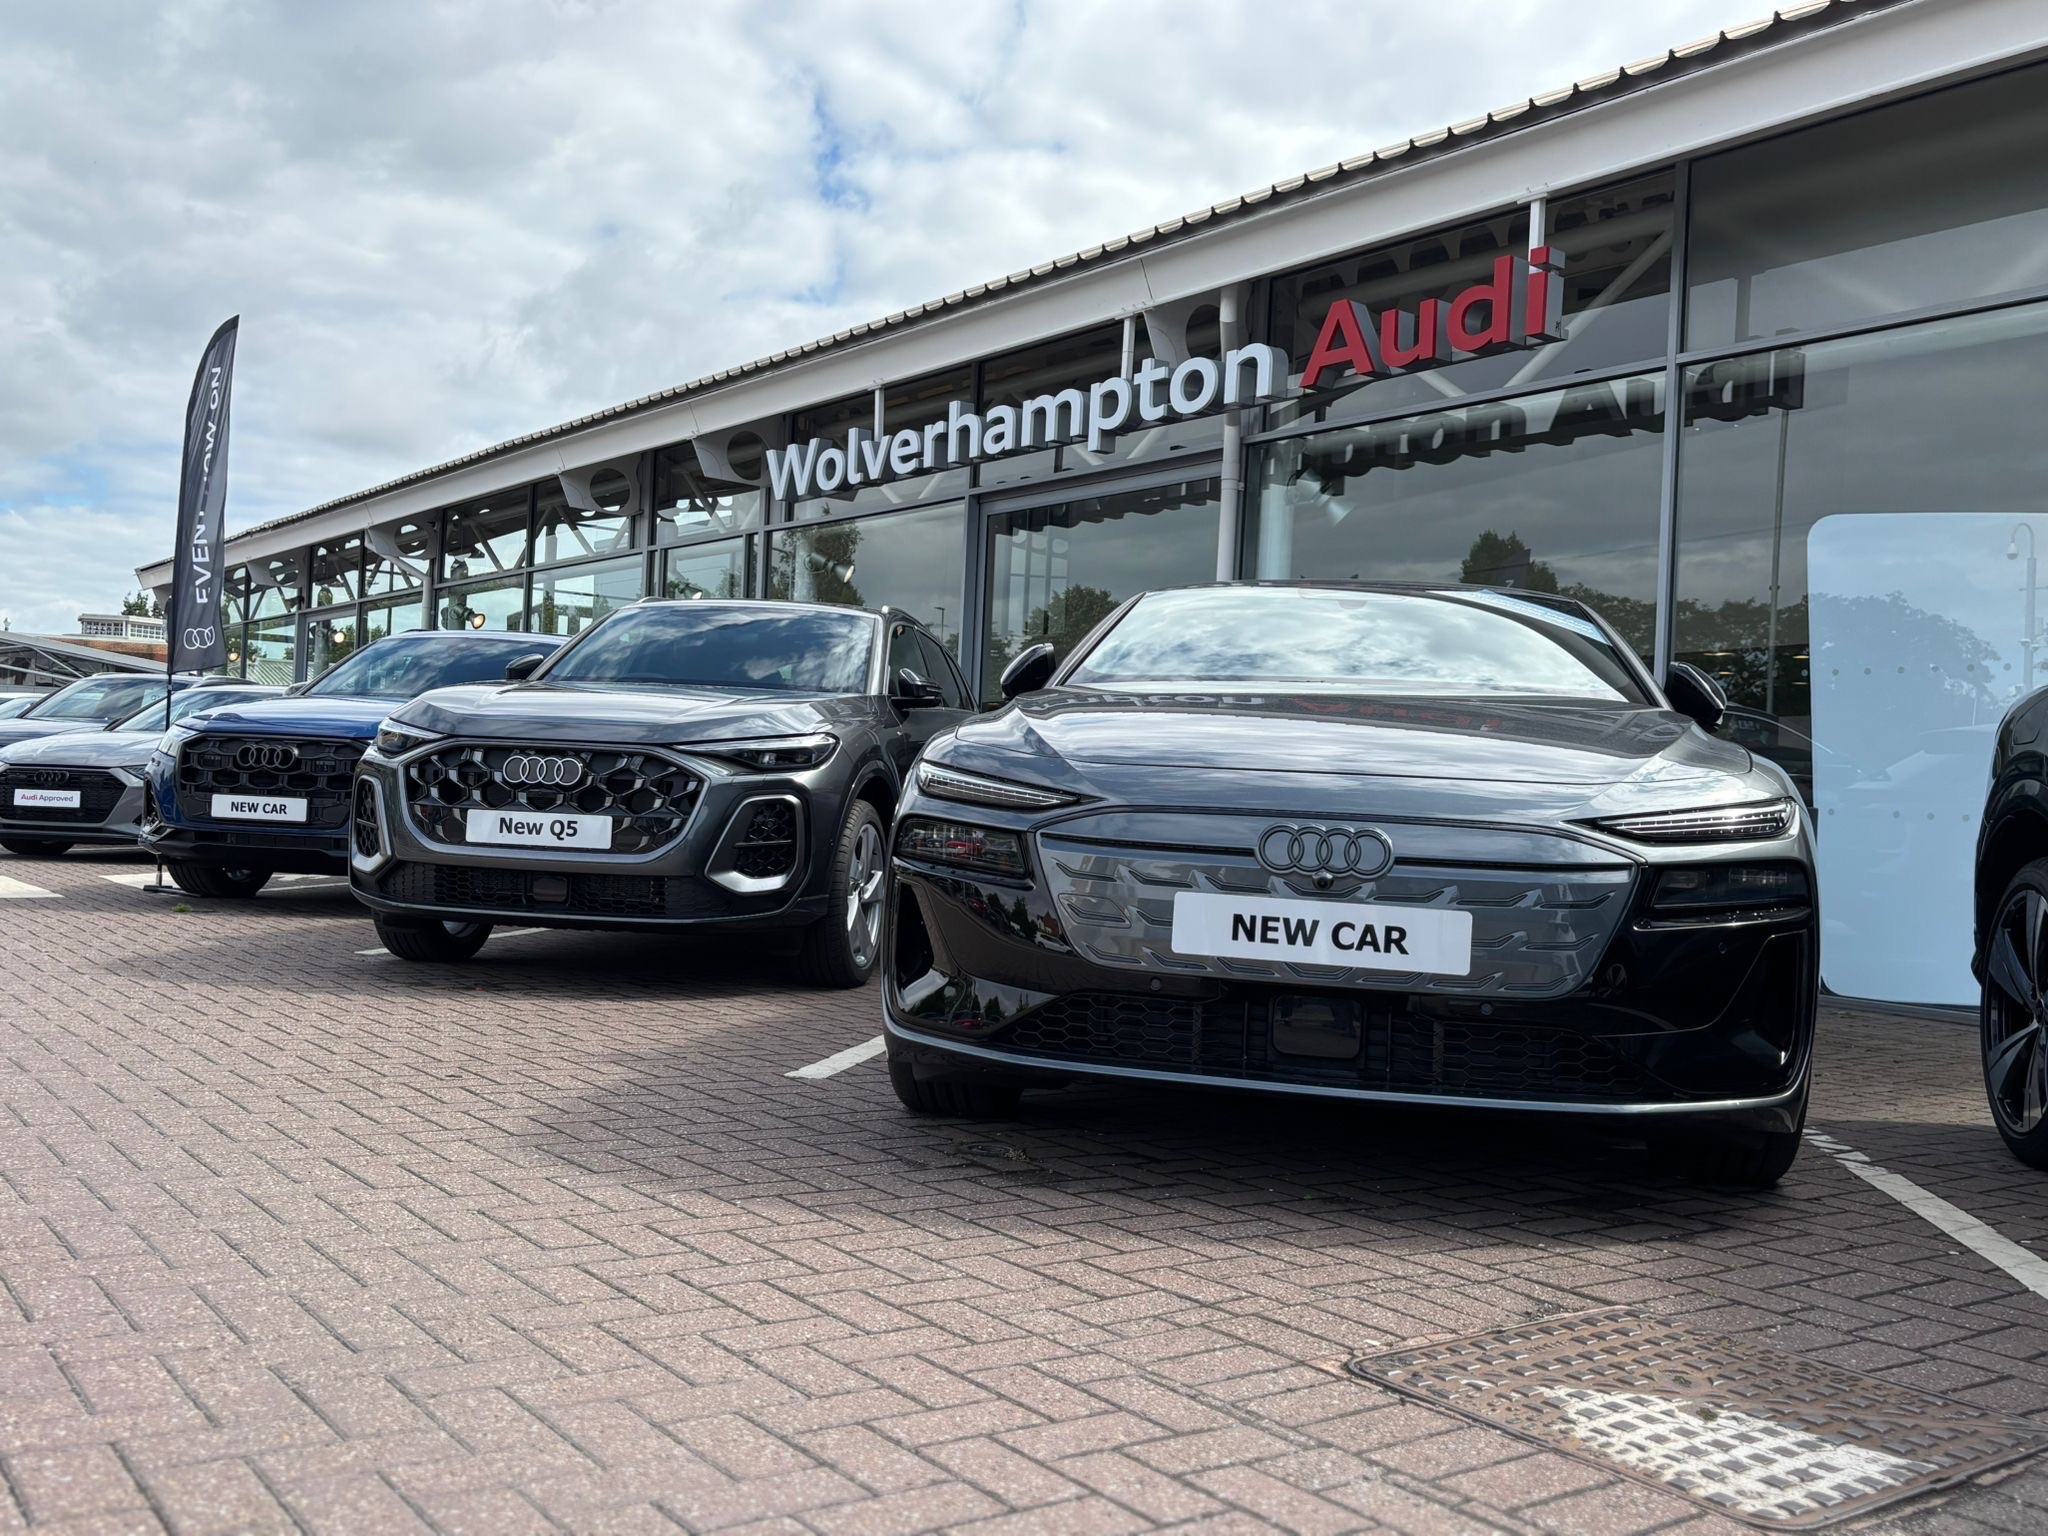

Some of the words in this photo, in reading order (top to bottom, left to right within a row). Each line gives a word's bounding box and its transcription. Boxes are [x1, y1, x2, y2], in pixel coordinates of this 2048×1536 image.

[766, 341, 1276, 500] Wolverhampton
[1302, 246, 1549, 388] Audi
[192, 511, 212, 604] EVEN
[203, 421, 217, 482] OW
[210, 366, 221, 410] ON
[21, 793, 38, 801] Audi
[39, 794, 74, 802] Approved
[231, 801, 259, 813] NEW
[262, 803, 287, 815] CAR
[499, 817, 544, 836] New
[550, 819, 578, 841] Q5
[1232, 913, 1320, 947] NEW
[1331, 921, 1409, 955] CAR
